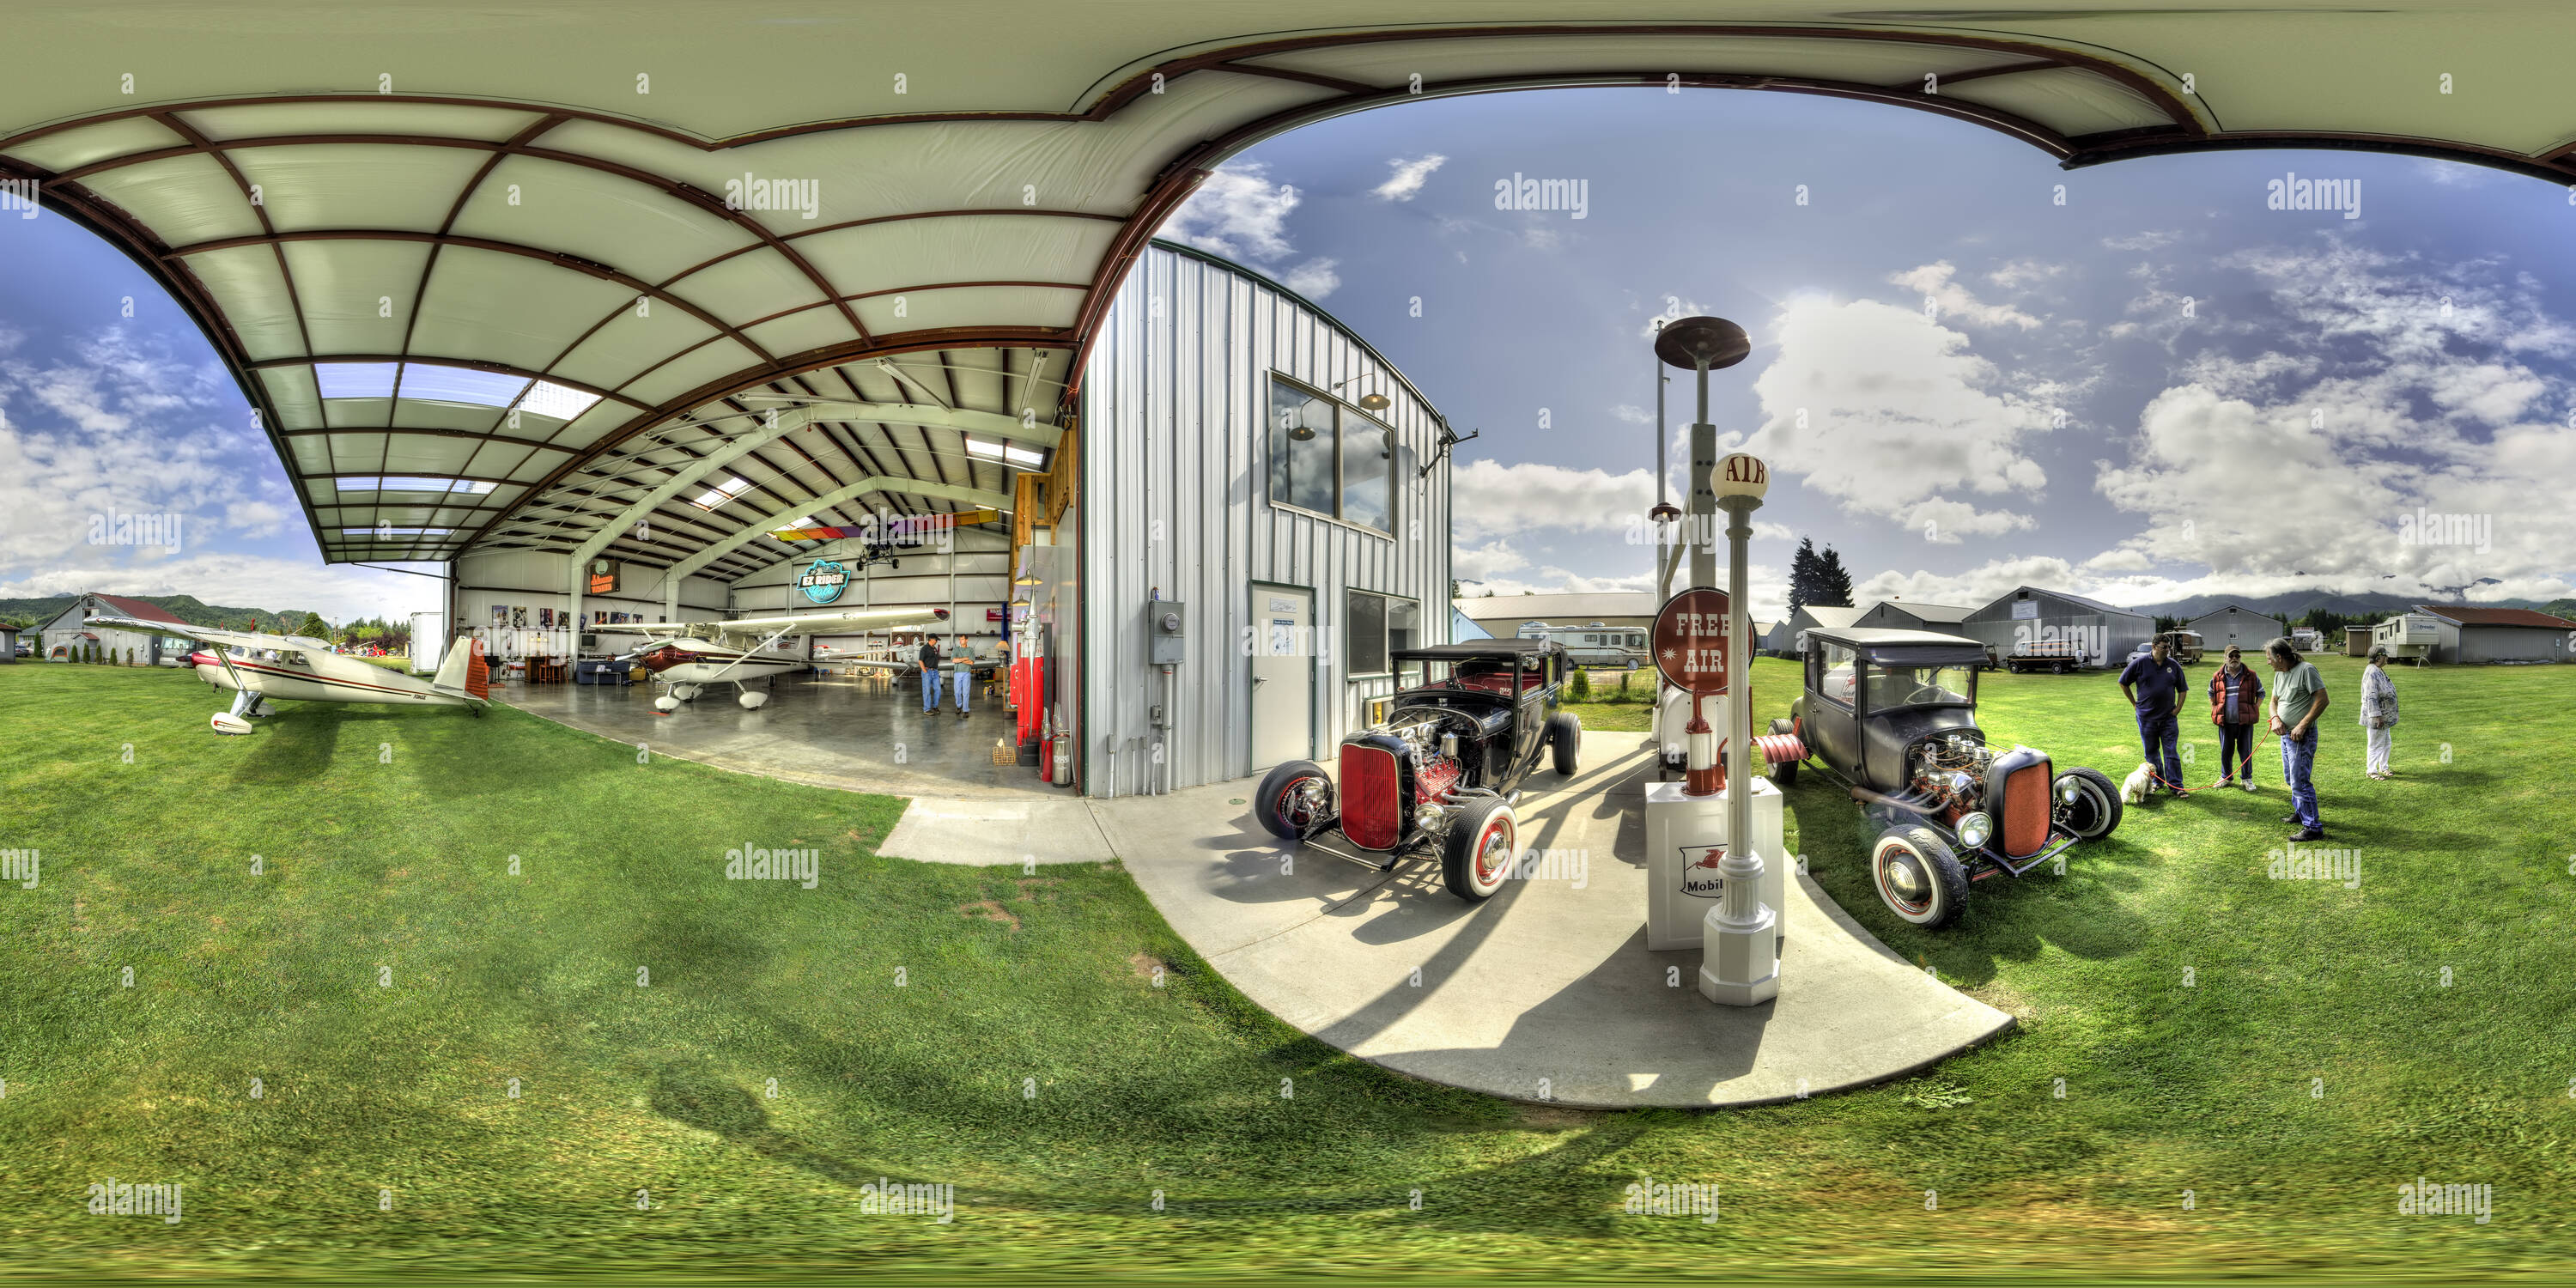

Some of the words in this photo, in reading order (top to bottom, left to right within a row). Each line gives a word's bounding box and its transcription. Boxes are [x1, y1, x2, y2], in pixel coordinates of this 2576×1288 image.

[1726, 456, 1765, 483] AIR
[802, 576, 814, 586] EZ
[815, 574, 844, 585] RIDER
[1676, 613, 1729, 636] FREE
[1684, 649, 1724, 672] AIR
[1687, 878, 1723, 892] Mobil
